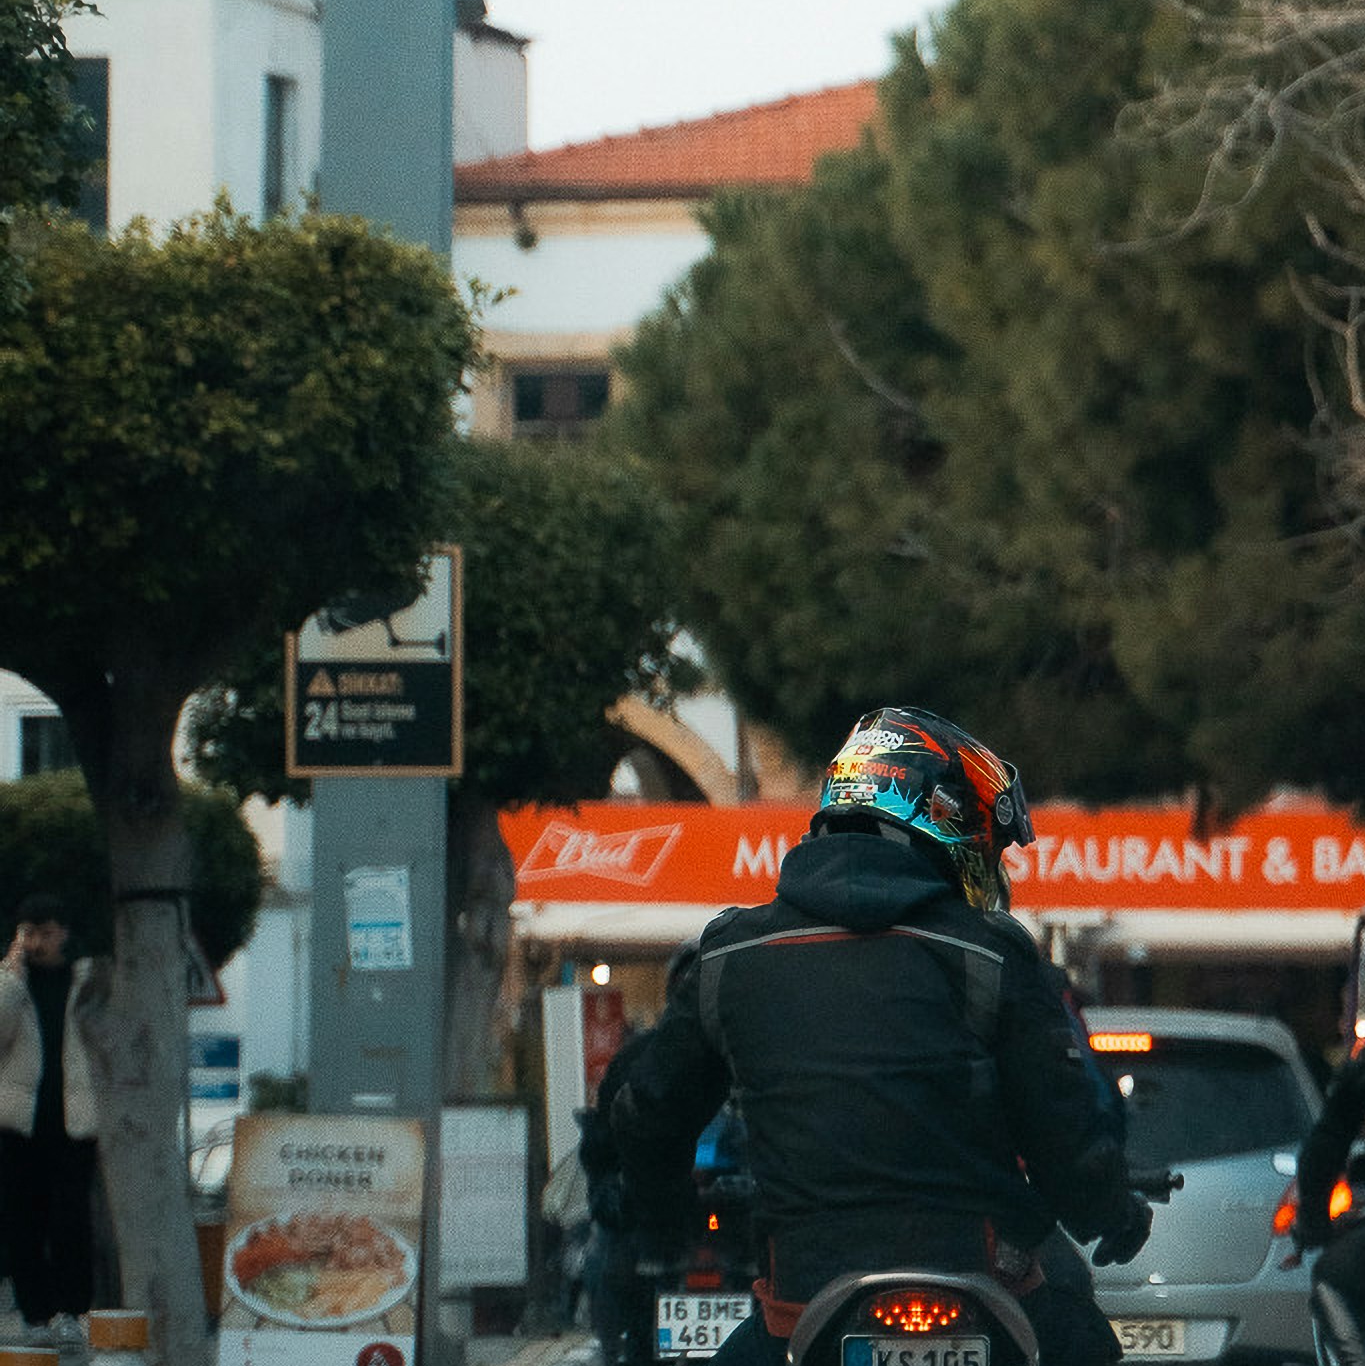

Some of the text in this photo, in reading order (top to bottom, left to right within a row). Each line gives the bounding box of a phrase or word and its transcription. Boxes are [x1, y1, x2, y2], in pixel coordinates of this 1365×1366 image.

[304, 700, 339, 741] 24
[555, 831, 641, 870] Bud
[1000, 837, 1249, 884] STAURANT
[1262, 836, 1298, 884] &
[279, 1143, 385, 1165] CHICKEN
[664, 1300, 746, 1321] 16 BME
[678, 1325, 721, 1346] 461
